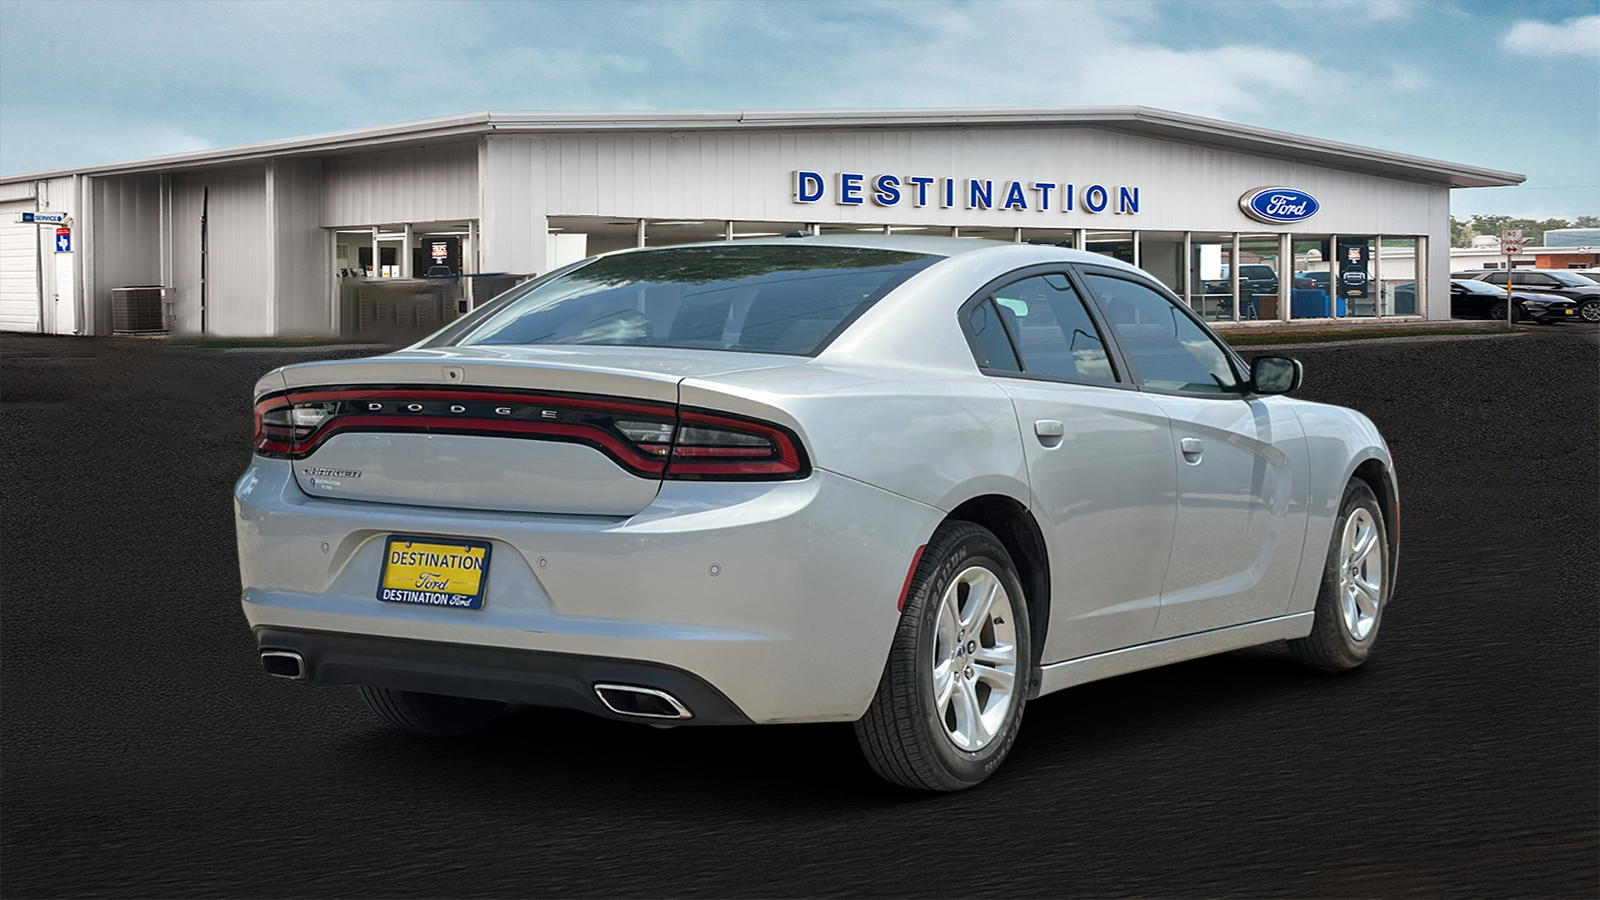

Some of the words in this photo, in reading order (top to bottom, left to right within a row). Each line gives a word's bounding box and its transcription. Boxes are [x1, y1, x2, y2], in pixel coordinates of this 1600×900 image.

[797, 171, 1140, 214] DESTINATION
[1266, 194, 1307, 216] Ford
[368, 403, 557, 419] DODGE
[302, 467, 362, 477] CHARGER
[391, 551, 483, 571] DESTINATION
[415, 572, 450, 591] Ford
[383, 589, 448, 605] DESTINATION
[449, 594, 472, 607] Ford
